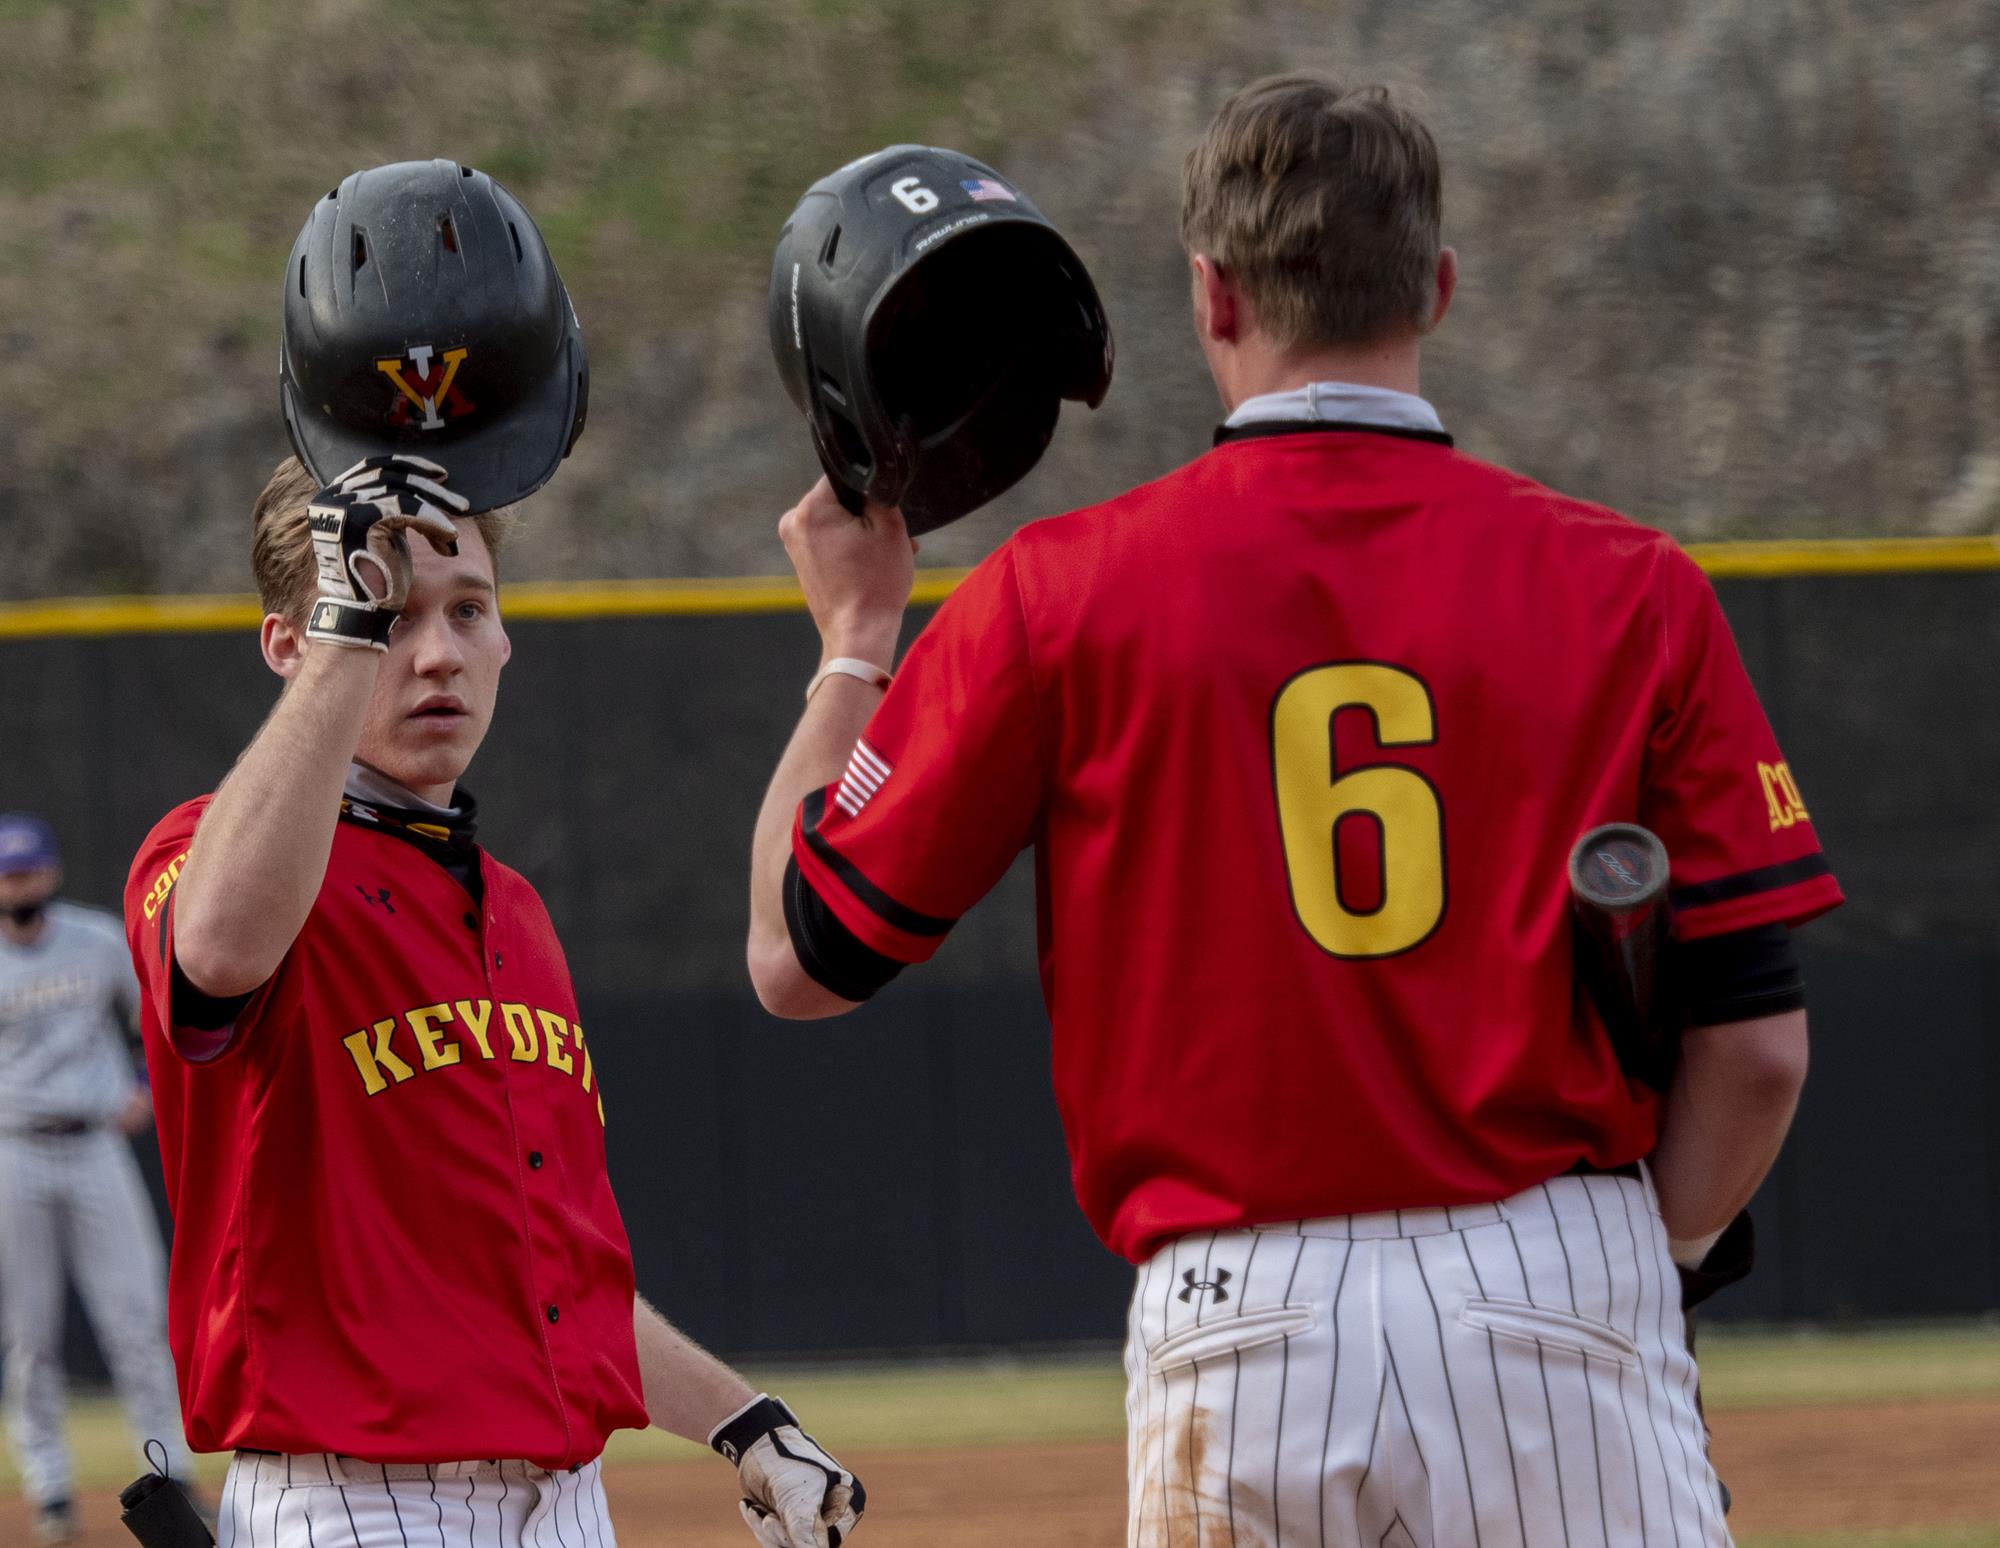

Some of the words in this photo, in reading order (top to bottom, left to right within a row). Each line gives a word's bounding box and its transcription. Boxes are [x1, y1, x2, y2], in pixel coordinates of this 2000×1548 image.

[891, 177, 939, 213] 6
[1269, 659, 1448, 961] 6
[341, 998, 605, 1126] KEYDET
